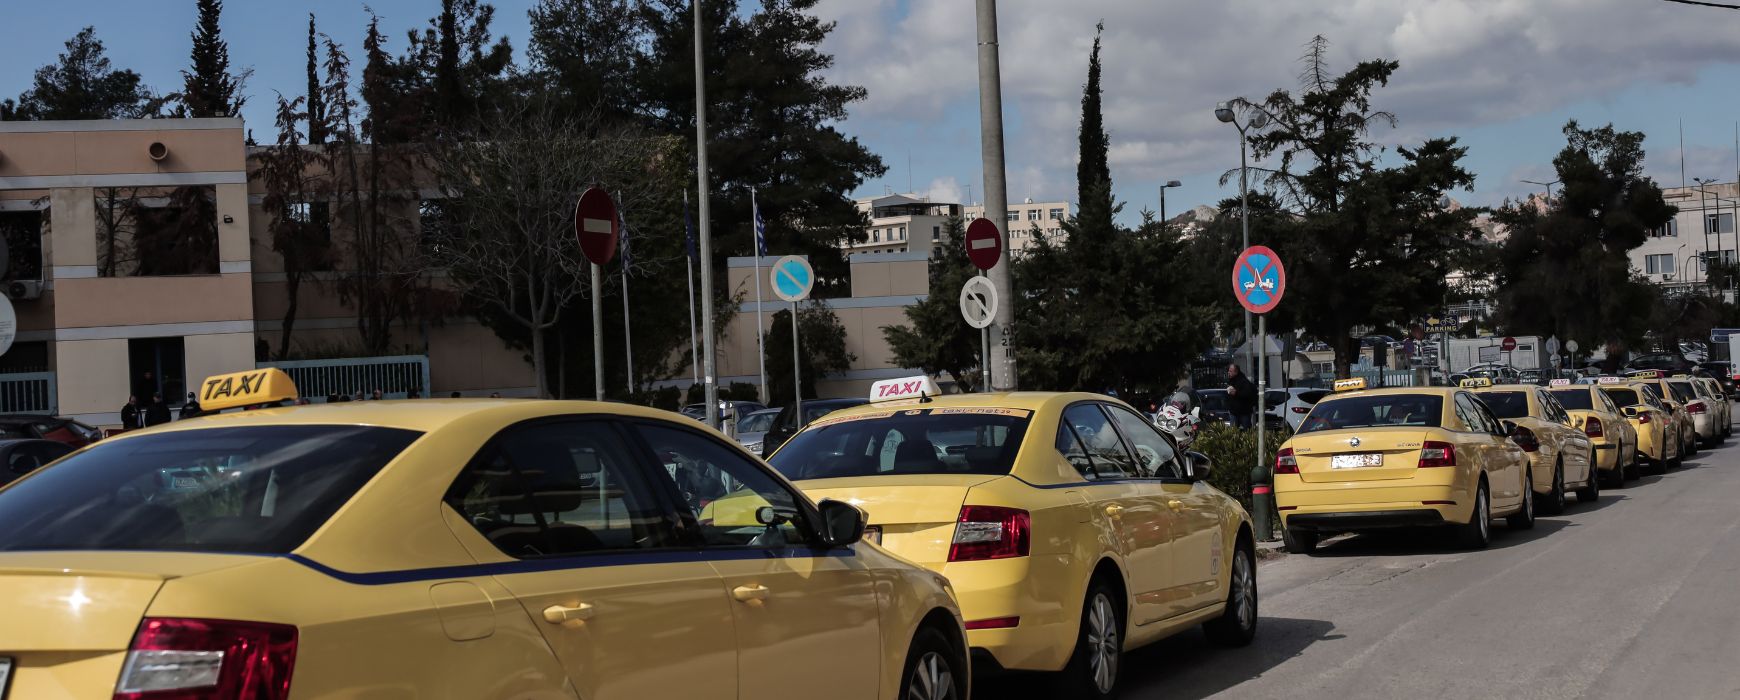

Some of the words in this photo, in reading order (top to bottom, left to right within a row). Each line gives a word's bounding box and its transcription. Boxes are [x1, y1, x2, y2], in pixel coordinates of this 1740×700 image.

[204, 372, 268, 400] TAXI
[878, 380, 922, 398] TAXI
[1463, 379, 1487, 387] TAXI
